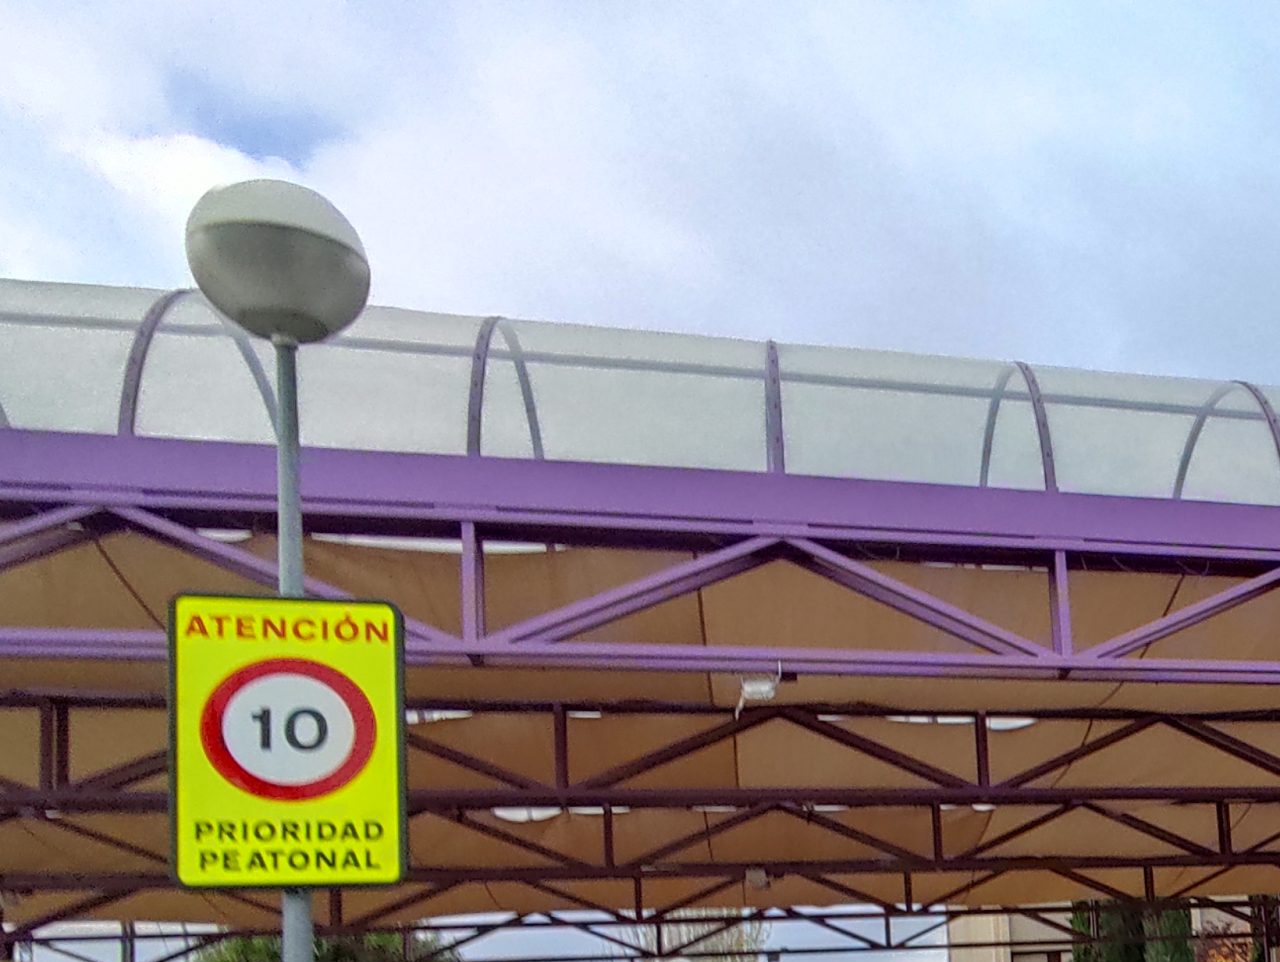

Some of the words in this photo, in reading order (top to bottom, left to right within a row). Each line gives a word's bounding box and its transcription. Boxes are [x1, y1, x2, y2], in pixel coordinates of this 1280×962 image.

[186, 613, 389, 643] ATENCIÓN
[251, 707, 328, 752] 10
[195, 821, 385, 843] PRIORIDAD
[199, 849, 381, 873] PEATONAL
